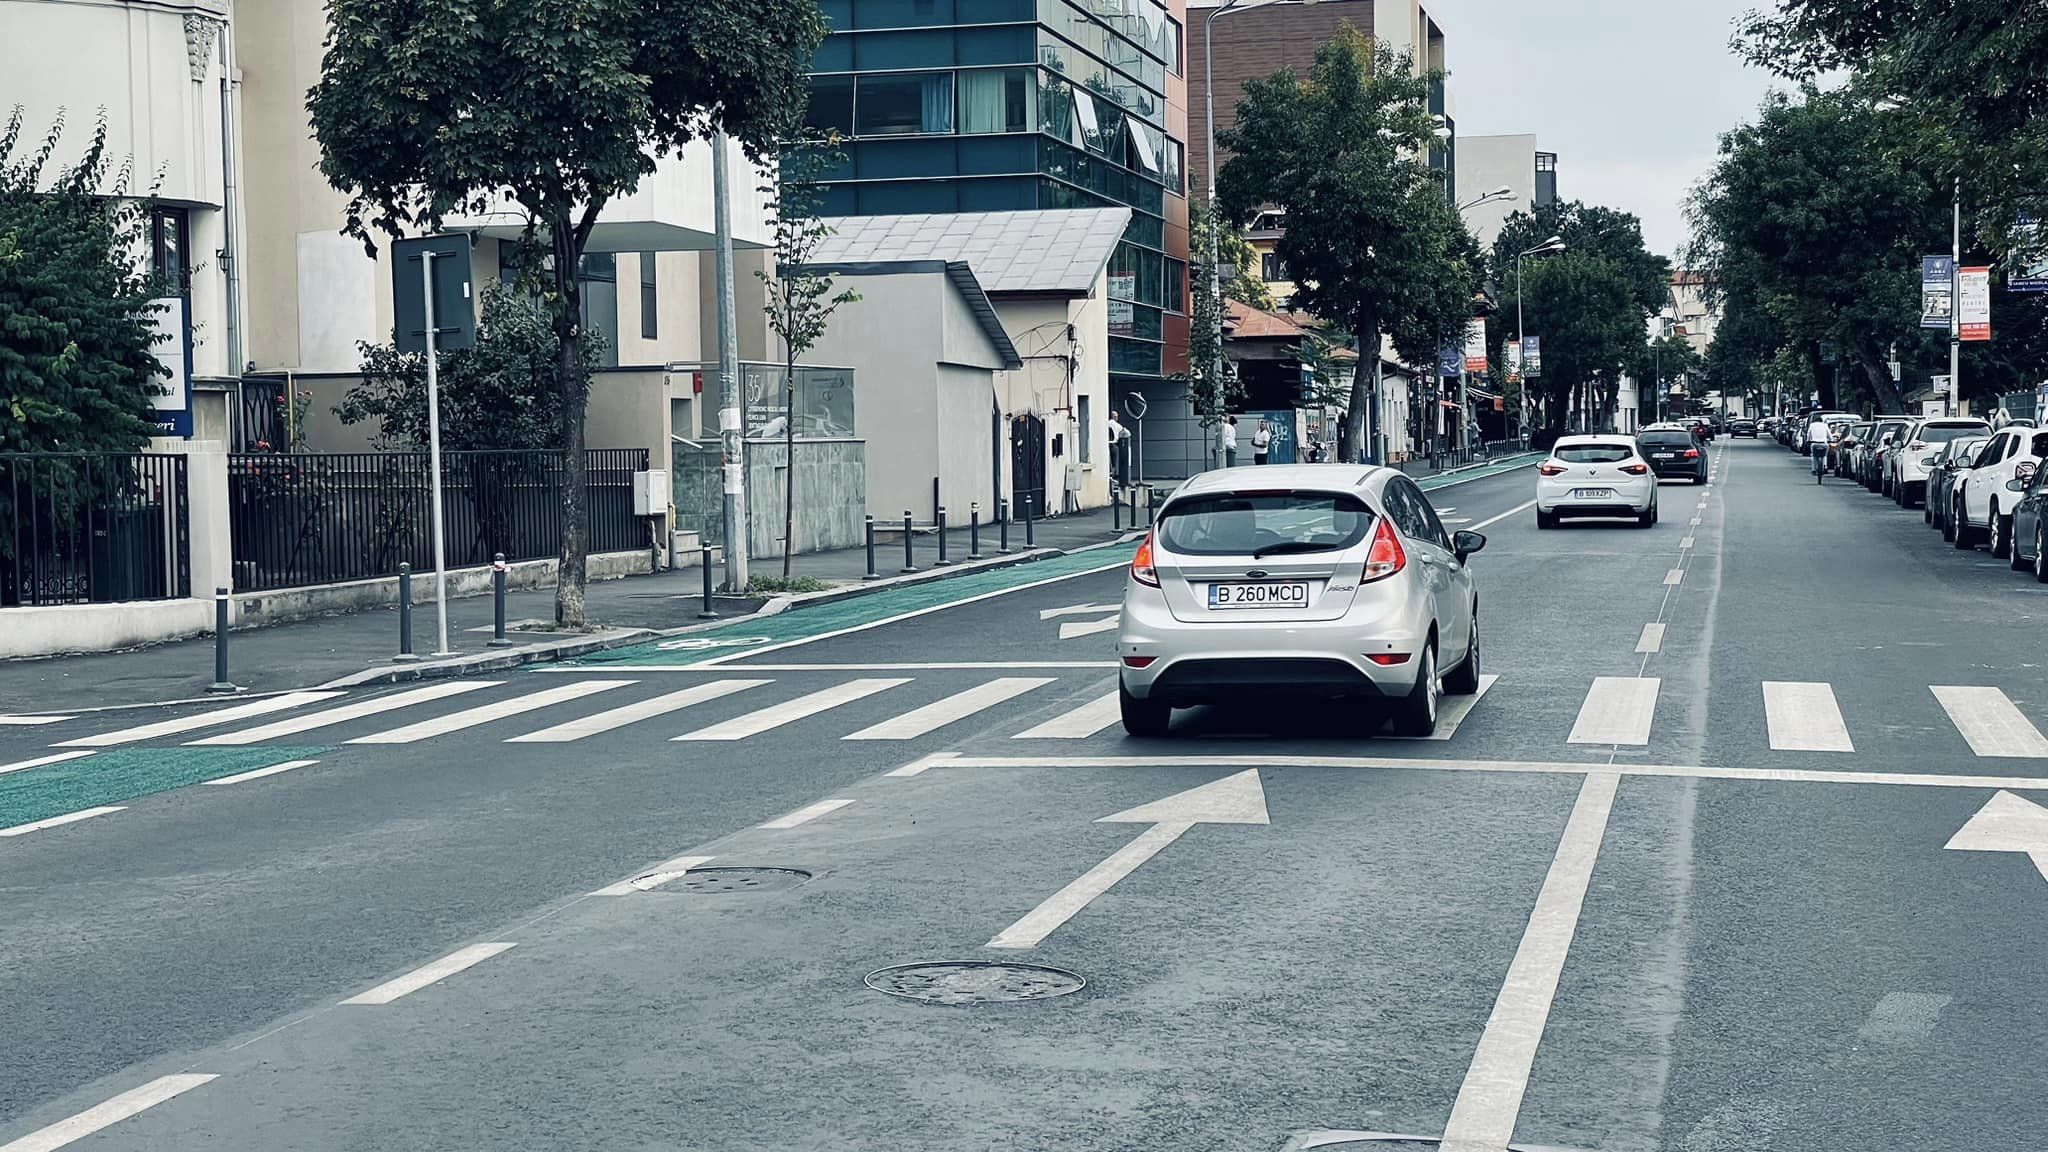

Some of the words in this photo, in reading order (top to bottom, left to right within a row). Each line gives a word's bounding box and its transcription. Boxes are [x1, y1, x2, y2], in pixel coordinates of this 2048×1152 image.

[748, 374, 761, 402] 35
[1218, 587, 1230, 602] B
[1236, 586, 1265, 601] 260
[1268, 585, 1304, 601] MCD
